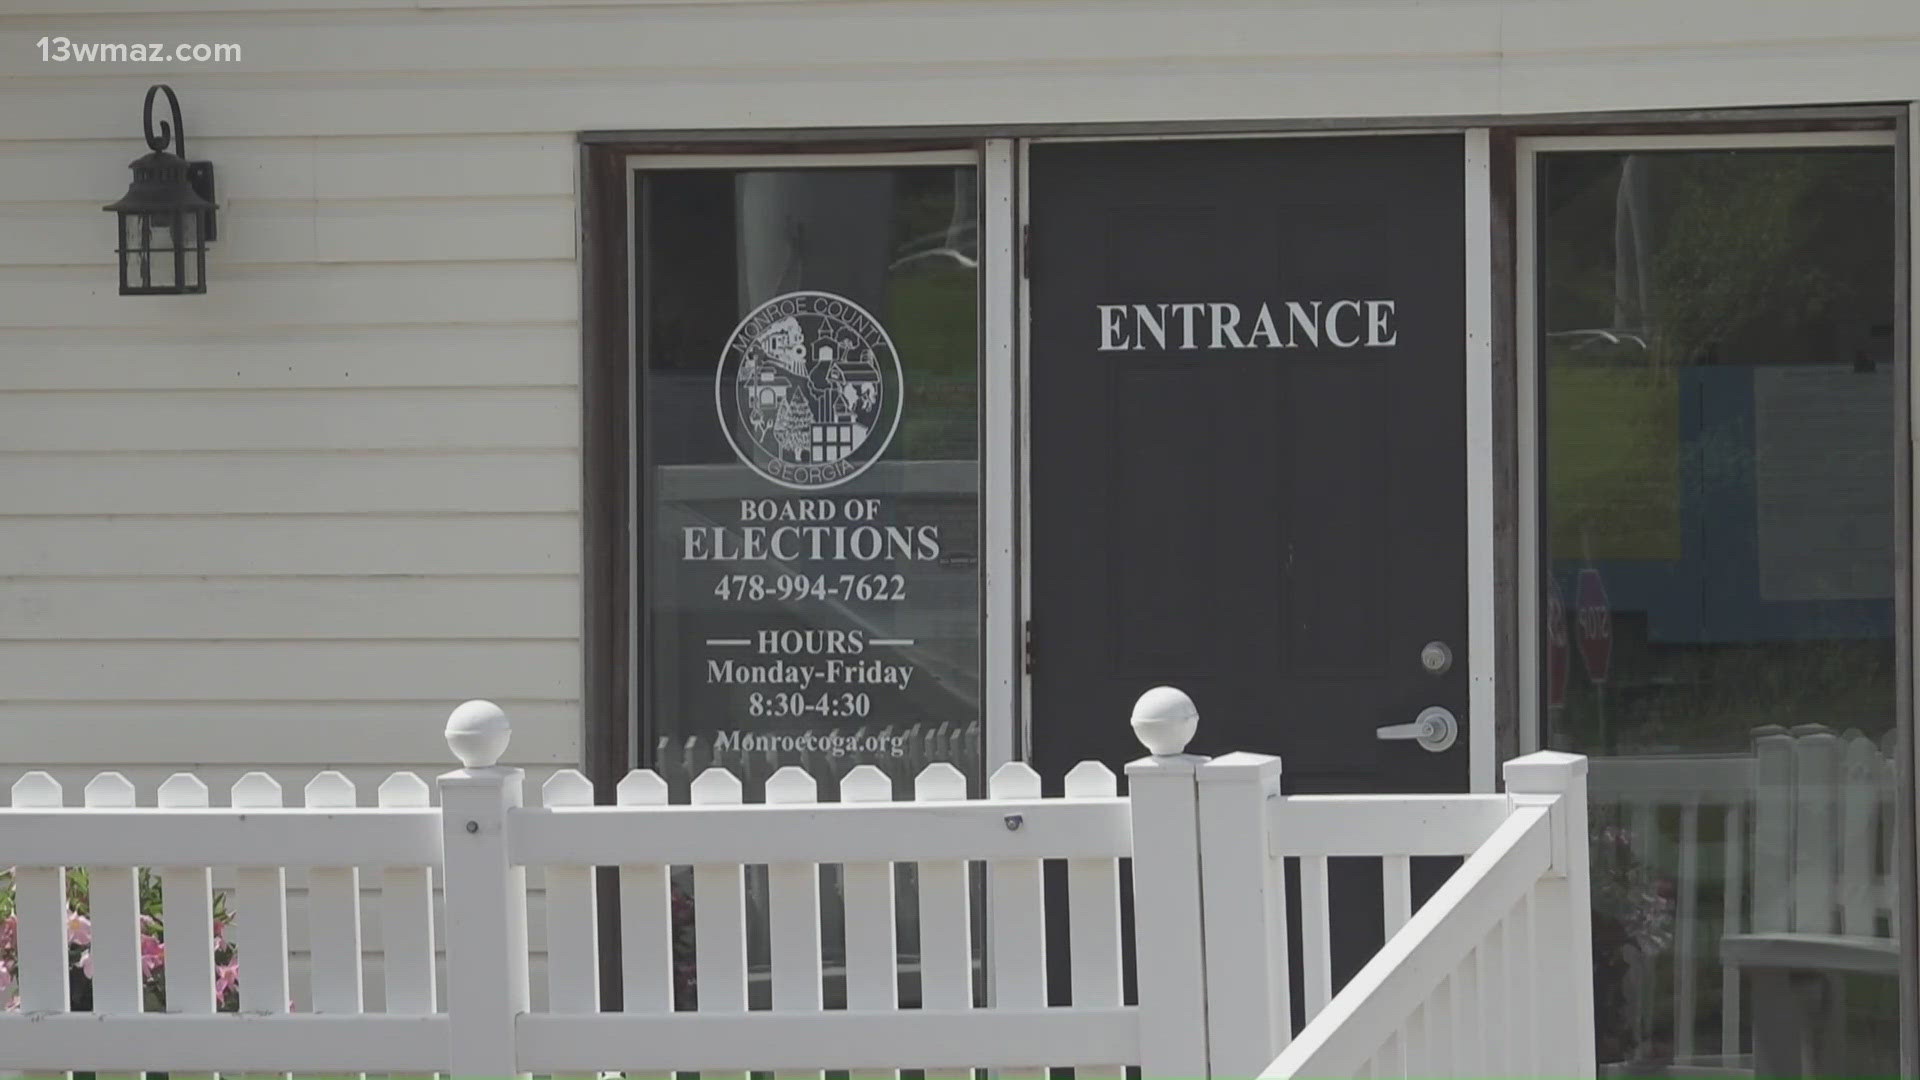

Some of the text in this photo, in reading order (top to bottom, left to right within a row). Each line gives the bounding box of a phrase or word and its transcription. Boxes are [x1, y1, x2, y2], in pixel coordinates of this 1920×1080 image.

[732, 297, 888, 353] MONROE COUNTY
[1096, 299, 1398, 351] ENTRANCE
[767, 458, 855, 484] GEORGIA
[740, 499, 881, 521] BOARD OF
[682, 525, 940, 561] ELECTIONS
[714, 574, 906, 601] 478-994-7622
[757, 629, 864, 655] HOURS
[707, 659, 914, 690] Monday-Friday
[749, 692, 870, 717] 8:30-4:30
[717, 730, 904, 757] Monroecoga.org
